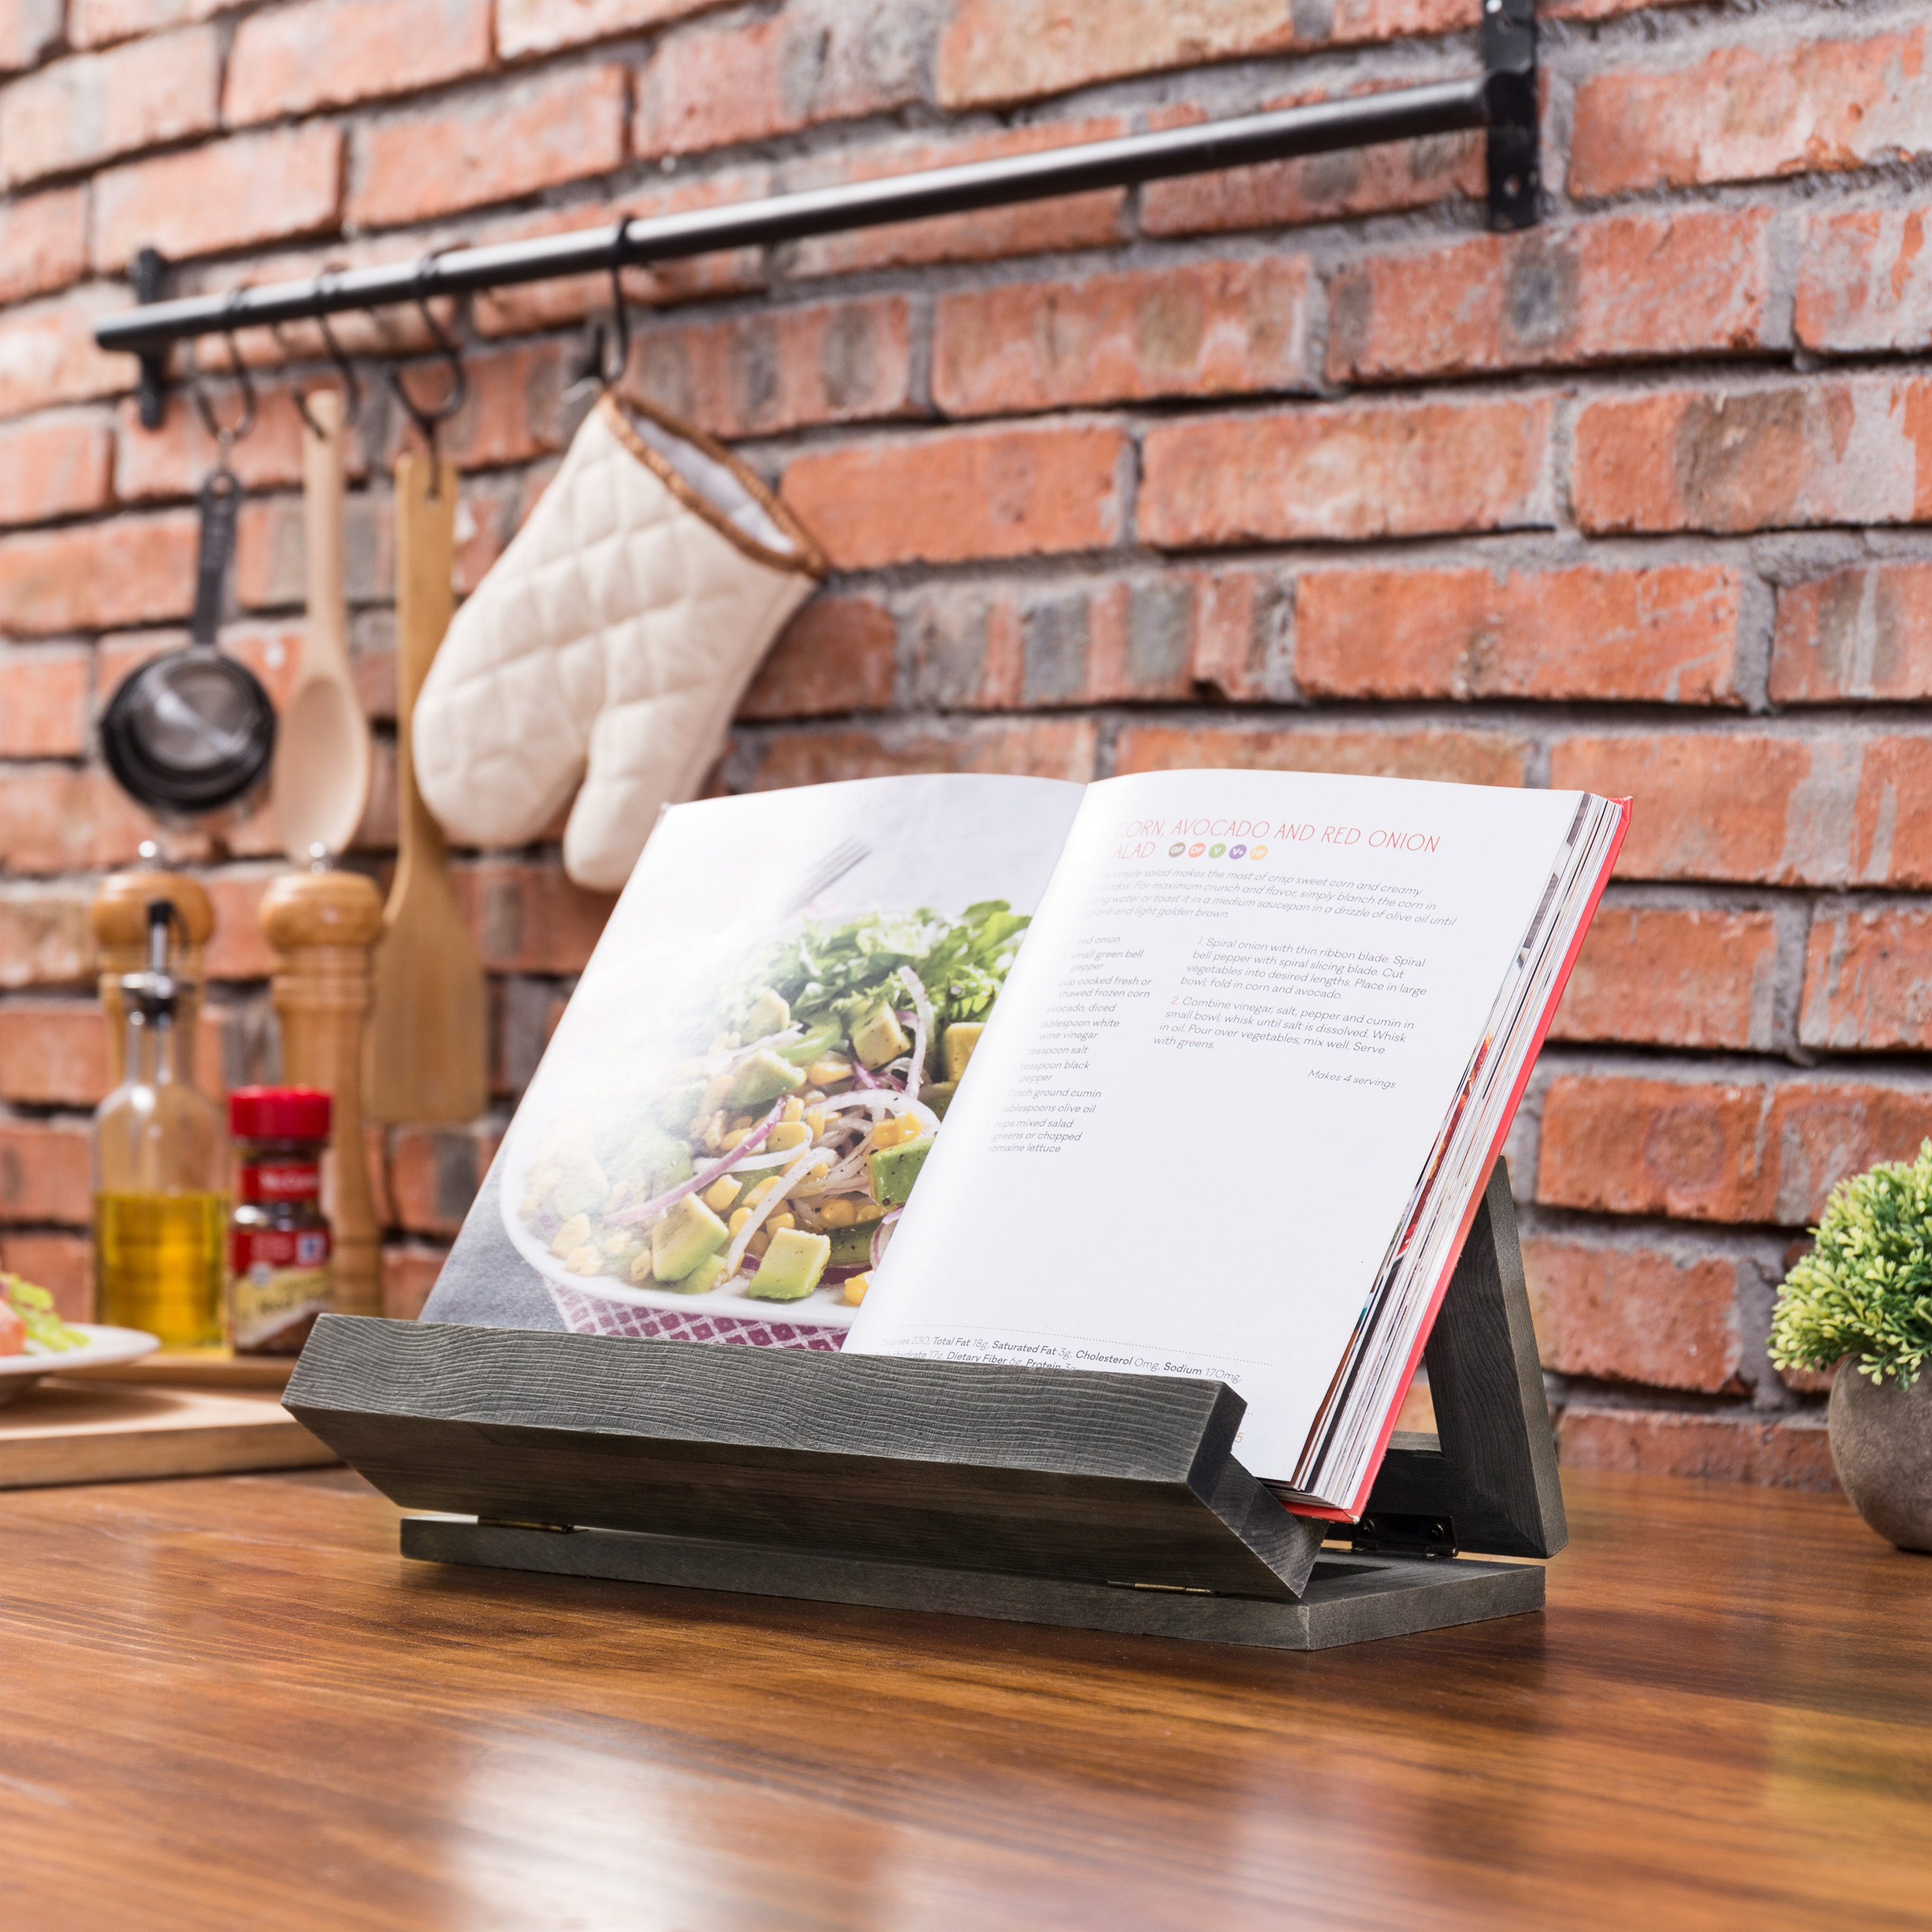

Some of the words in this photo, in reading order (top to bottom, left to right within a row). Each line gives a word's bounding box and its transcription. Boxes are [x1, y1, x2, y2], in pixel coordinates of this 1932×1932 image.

[1170, 819, 1270, 838] AVOCADO
[1273, 824, 1315, 841] AND
[1320, 826, 1361, 844] RED
[1368, 829, 1440, 852] ONION
[1143, 868, 1173, 877] salad
[1172, 869, 1206, 877] makes
[1207, 869, 1225, 878] the
[1226, 872, 1253, 880] most
[1254, 871, 1269, 881] of
[1267, 875, 1294, 885] crisp
[1295, 877, 1329, 886] sweet
[1356, 882, 1381, 891] and
[1380, 886, 1423, 896] creamy
[1133, 880, 1150, 890] For
[1203, 884, 1240, 892] crunch
[1242, 886, 1266, 895] and
[1300, 891, 1336, 902] simply
[1336, 892, 1375, 904] blanch
[1377, 896, 1396, 906] the
[1397, 900, 1424, 909] corn
[1425, 902, 1437, 911] in
[1112, 895, 1141, 903] water
[1153, 894, 1181, 902] toast
[1181, 894, 1191, 903] it
[1212, 896, 1256, 906] medium
[1256, 901, 1310, 912] saucepan
[1311, 903, 1323, 912] in
[1334, 905, 1370, 917] drizzle
[1371, 909, 1387, 918] of
[1385, 911, 1412, 922] olive
[1414, 914, 1430, 923] oil
[1429, 917, 1458, 926] until
[1113, 907, 1135, 916] and
[1133, 906, 1158, 918] light
[1156, 907, 1194, 918] golden
[1094, 951, 1123, 961] green
[1124, 949, 1144, 958] bell
[1206, 937, 1237, 949] Spiral
[1237, 941, 1268, 951] onion
[1270, 943, 1293, 952] with
[1296, 945, 1317, 955] thin
[1319, 948, 1356, 959] ribbon
[1392, 955, 1426, 967] Spiral
[1069, 963, 1104, 973] pepper
[1192, 949, 1213, 959] bell
[1211, 954, 1252, 963] pepper
[1254, 956, 1277, 965] with
[1278, 958, 1309, 969] spiral
[1310, 960, 1345, 975] slicing
[1382, 967, 1405, 979] Cut
[1077, 976, 1113, 985] cooked
[1113, 976, 1139, 985] fresh
[1187, 965, 1242, 976] vegetables
[1244, 968, 1266, 978] into
[1267, 970, 1309, 981] desired
[1354, 978, 1384, 990] Place
[1386, 982, 1397, 992] in
[1399, 983, 1427, 998] large
[1210, 978, 1233, 988] fold
[1233, 980, 1243, 989] in
[1245, 983, 1270, 991] corn
[1271, 985, 1294, 994] and
[1094, 988, 1125, 997] frozen
[1088, 1003, 1117, 1012] diced
[1182, 996, 1231, 1009] Combine
[1299, 1010, 1341, 1021] pepper
[1342, 1014, 1365, 1023] and
[1366, 1018, 1401, 1027] cumin
[1403, 1019, 1414, 1029] in
[1092, 1018, 1120, 1027] white
[1164, 1010, 1193, 1019] small
[1224, 1014, 1254, 1025] whisk
[1256, 1018, 1283, 1027] until
[1282, 1020, 1303, 1030] salt
[1304, 1022, 1314, 1032] is
[1373, 1030, 1406, 1042] Whisk
[1063, 1032, 1099, 1042] vinegar
[1153, 1036, 1176, 1045] with
[1159, 1022, 1170, 1031] in
[1188, 1024, 1213, 1034] Pour
[1214, 1028, 1238, 1037] over
[1303, 1038, 1324, 1046] mix
[1352, 1041, 1385, 1054] Serve
[1070, 1045, 1088, 1054] salt
[1063, 1060, 1090, 1069] black
[1018, 1075, 1053, 1084] pepper
[1307, 1070, 1341, 1082] Makes
[1343, 1074, 1353, 1083] 4
[1353, 1077, 1397, 1090] servings
[1032, 1088, 1070, 1099] ground
[1070, 1089, 1102, 1097] cumin
[1057, 1103, 1081, 1113] olive
[1083, 1104, 1097, 1113] oil
[1016, 1118, 1048, 1127] mixed
[1047, 1119, 1075, 1128] salad
[1037, 1132, 1083, 1142] chopped
[1026, 1143, 1061, 1153] lettuce
[933, 1336, 956, 1345] Total
[954, 1337, 971, 1347] Fat
[992, 1340, 1040, 1353] Saturated
[1040, 1345, 1057, 1356] Fat
[1075, 1350, 1133, 1365] Cholesterol
[1163, 1362, 1202, 1374] Sodium
[947, 1351, 981, 1363] Dietary
[983, 1354, 1008, 1365] Fiber
[1026, 1358, 1061, 1369] Protein
